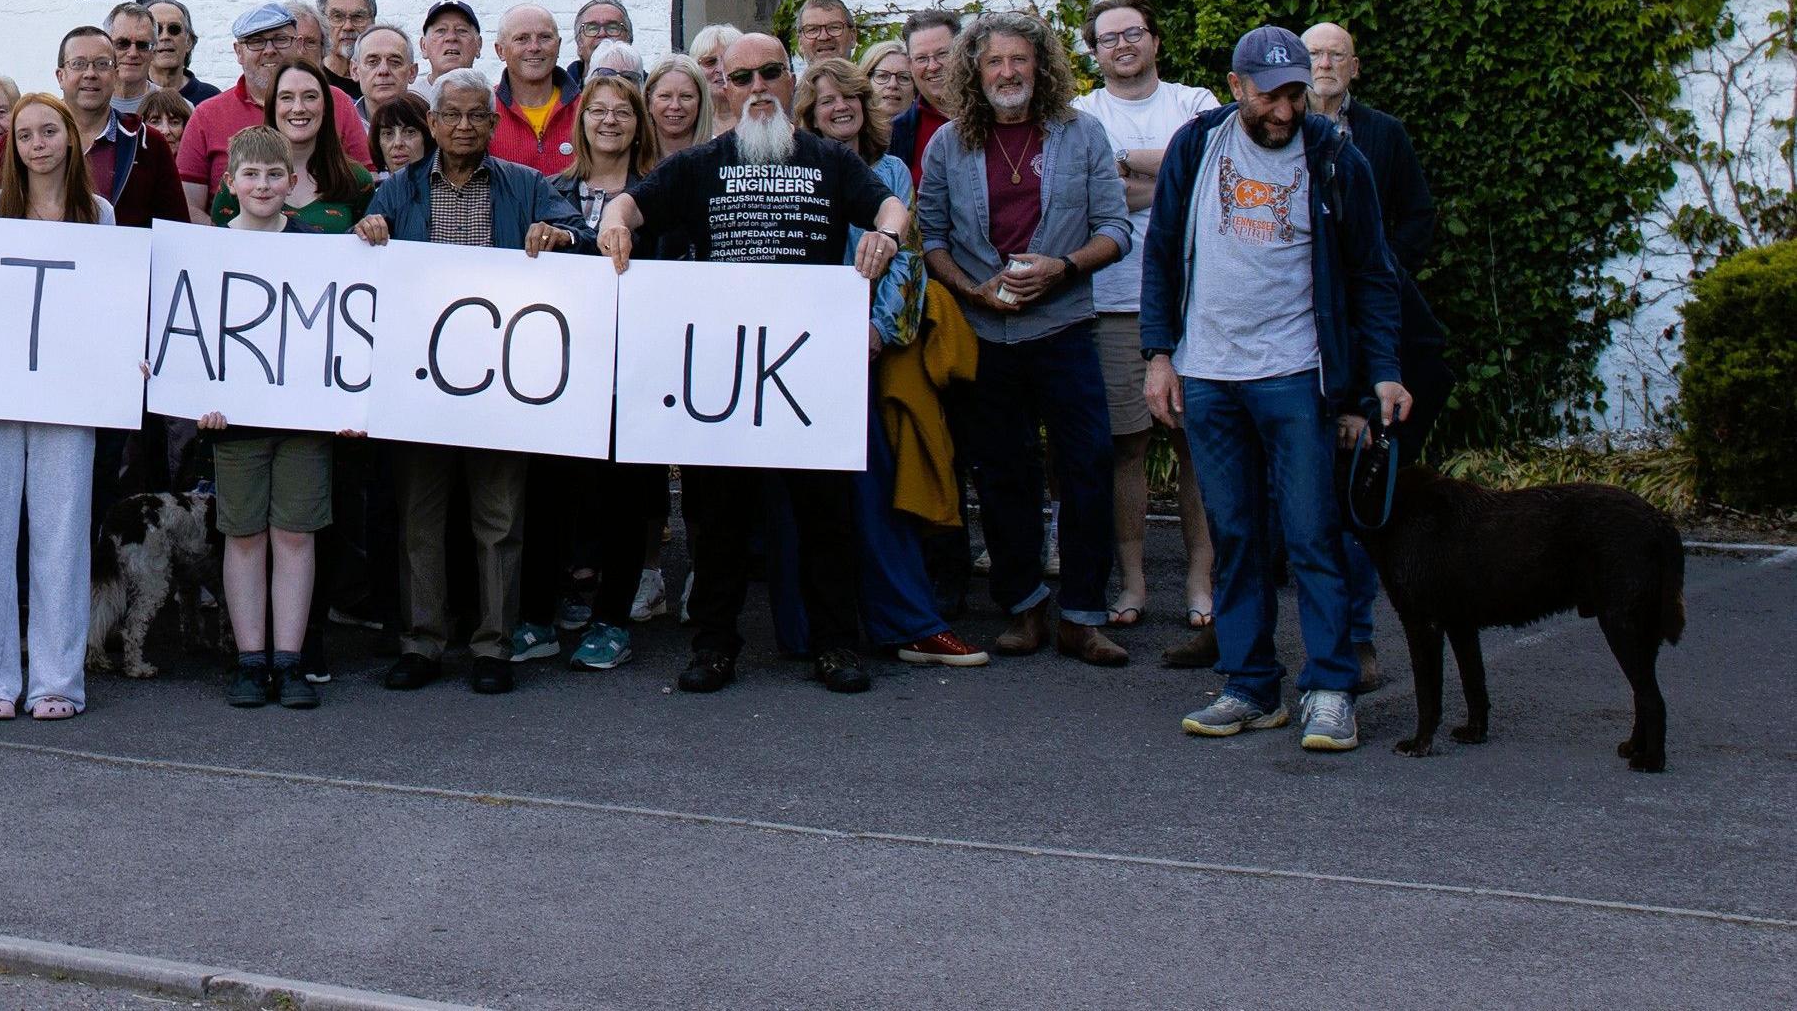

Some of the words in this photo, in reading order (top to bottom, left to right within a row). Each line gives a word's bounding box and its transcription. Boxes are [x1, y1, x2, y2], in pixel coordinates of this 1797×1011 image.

[719, 164, 823, 181] UNDERSTANDING
[725, 178, 815, 194] ENGINEERS
[709, 194, 764, 205] PERCUSSIVE
[765, 195, 830, 206] MAINTENANCE
[772, 203, 800, 211] working
[709, 213, 735, 223] CYCLE
[736, 211, 769, 220] POWER
[770, 212, 782, 220] TO
[784, 212, 802, 220] THE
[803, 213, 830, 224] PANEL
[1232, 215, 1277, 231] TENNESSEE
[760, 220, 778, 229] again
[730, 230, 785, 239] IMPEDANCE
[787, 230, 804, 238] AIR
[745, 238, 763, 246] plug
[748, 246, 807, 257] GROUNDING
[153, 269, 378, 393] ARMS
[415, 296, 571, 406] .CO
[664, 323, 812, 428] .UK
